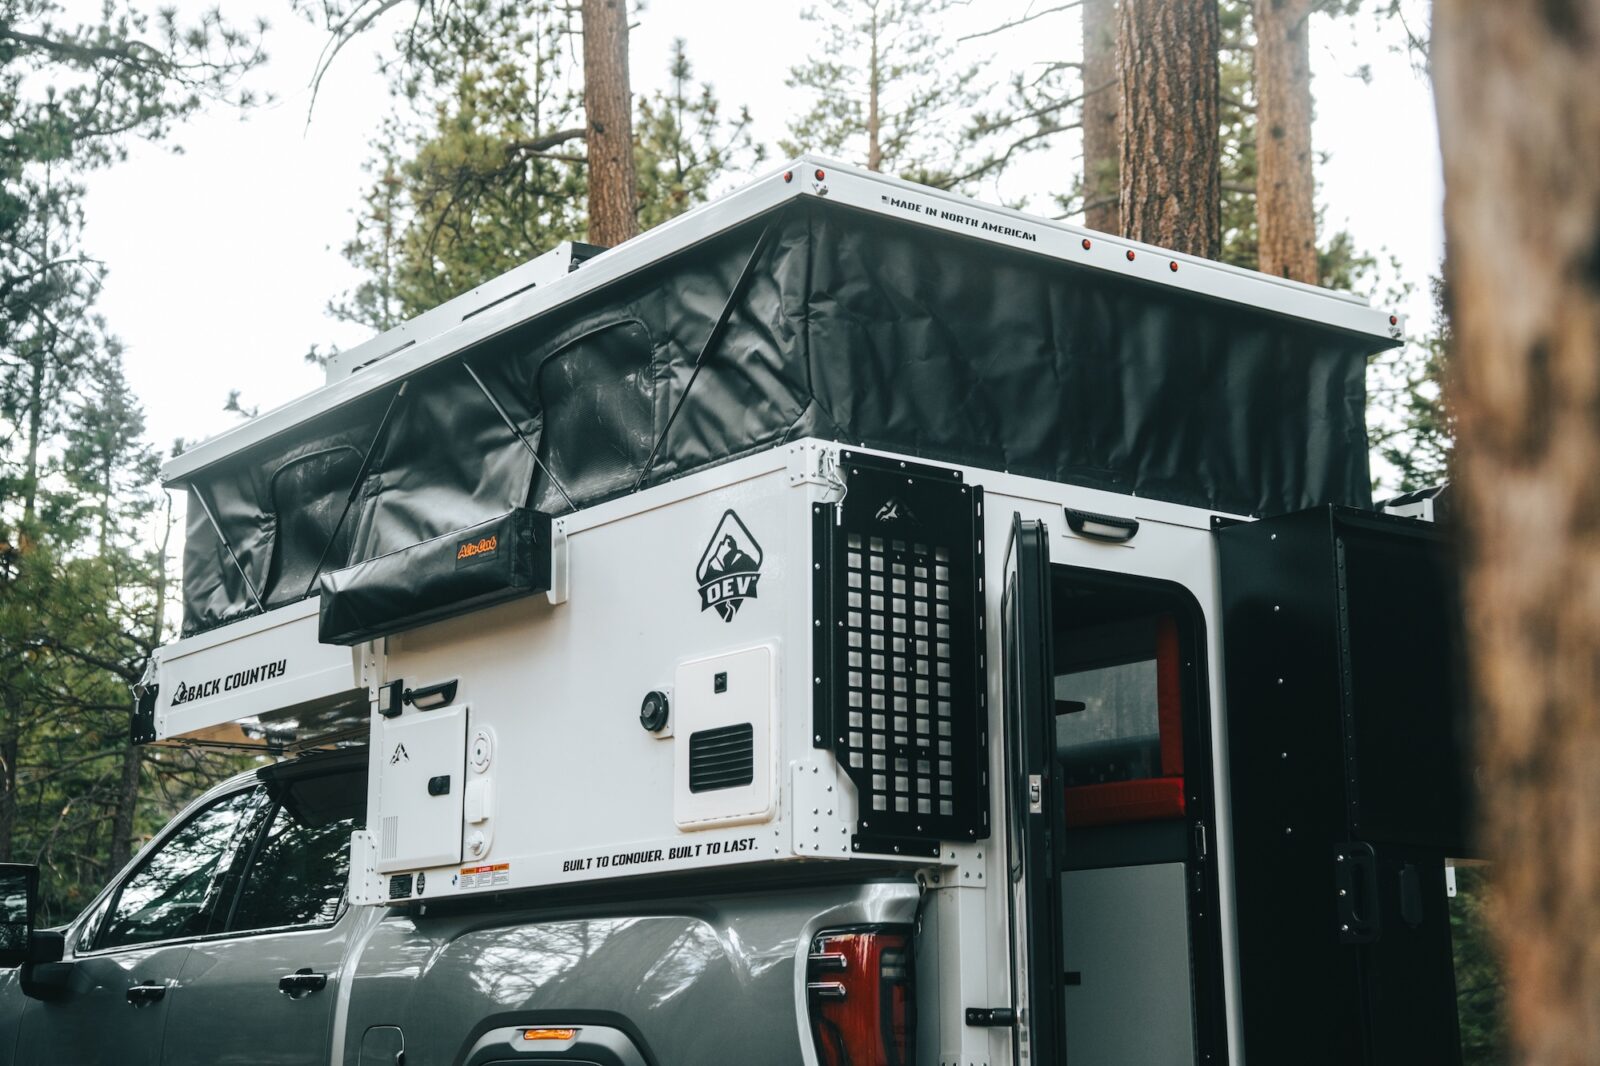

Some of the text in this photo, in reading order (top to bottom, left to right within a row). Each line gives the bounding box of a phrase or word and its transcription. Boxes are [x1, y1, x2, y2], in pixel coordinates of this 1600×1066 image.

[890, 198, 922, 213] MADE
[925, 206, 938, 218] IN
[940, 210, 979, 228] NORTH
[187, 658, 287, 702] BACK COUNTRY
[562, 837, 759, 873] BUILT TO CONQUER. BUILT TO LAST.
